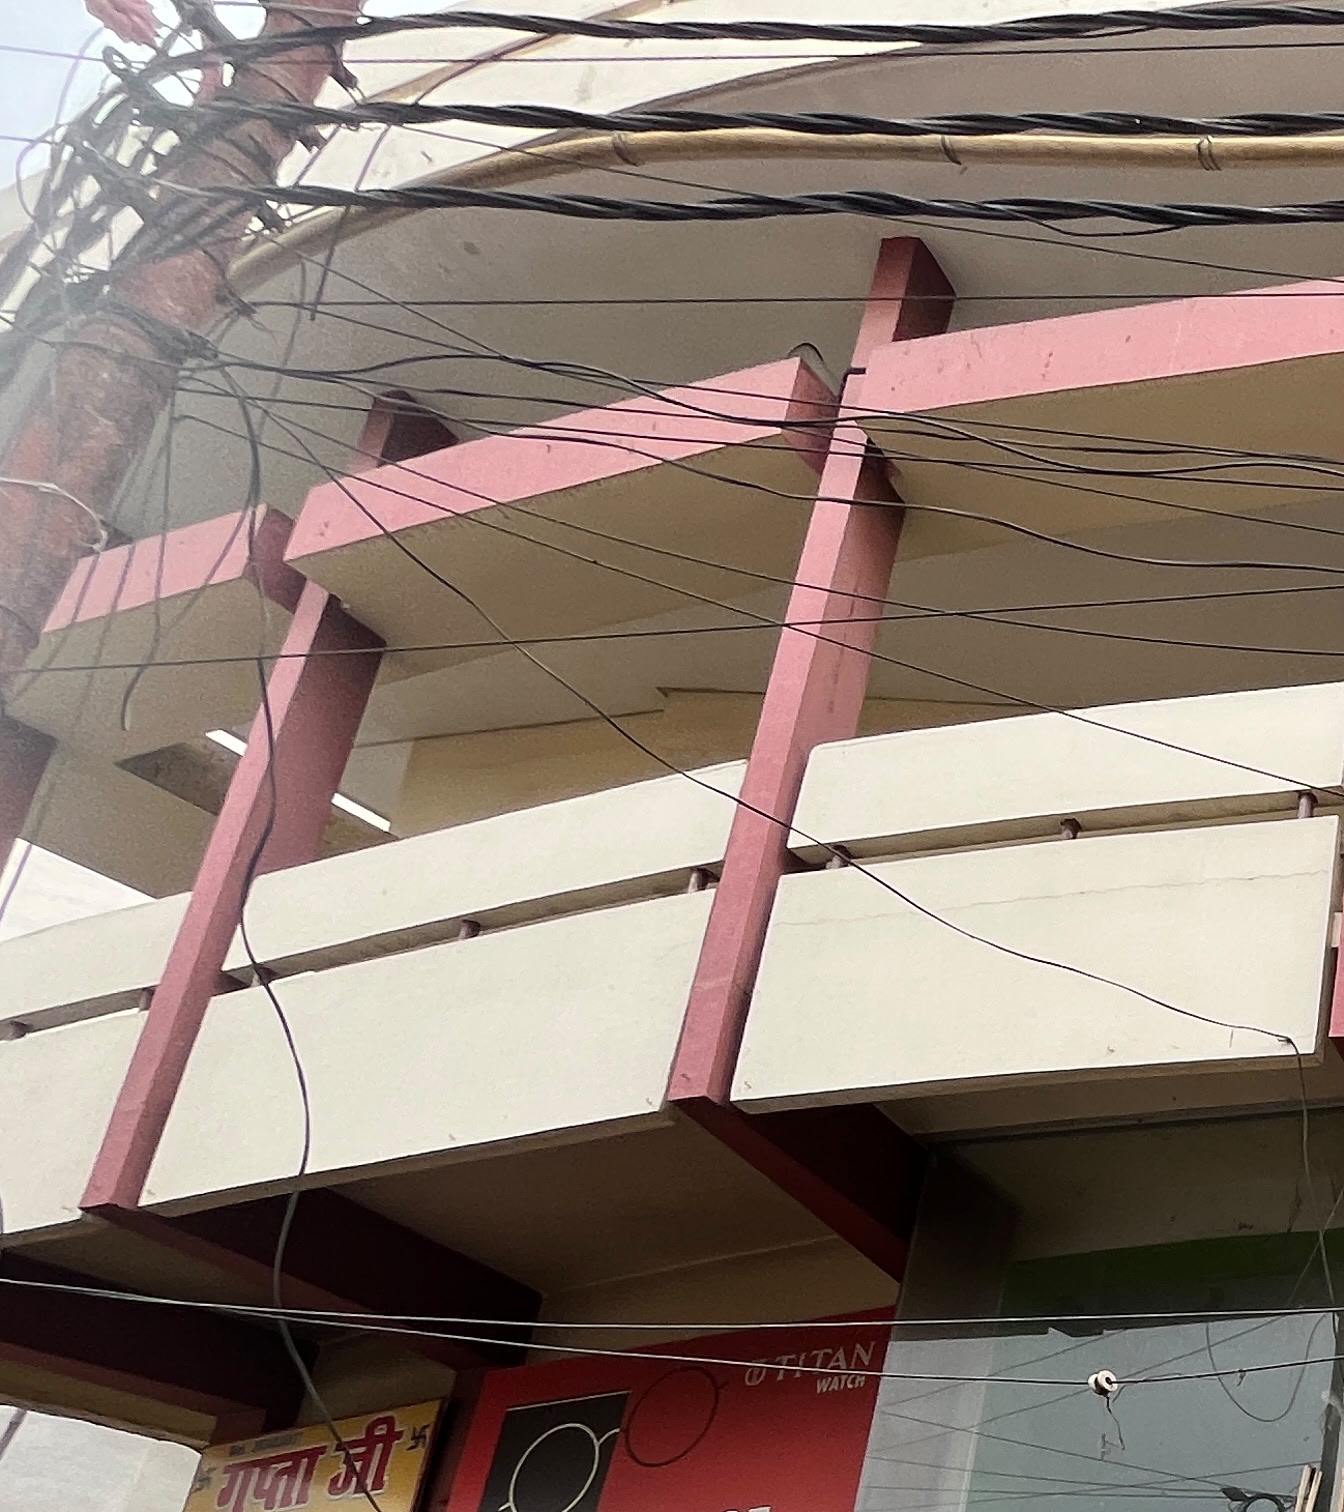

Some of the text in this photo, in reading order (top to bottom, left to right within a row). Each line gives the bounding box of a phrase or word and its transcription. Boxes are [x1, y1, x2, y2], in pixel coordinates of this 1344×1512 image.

[772, 1341, 876, 1381] TITAN
[816, 1374, 866, 1394] WATCH
[327, 1415, 405, 1497] जी
